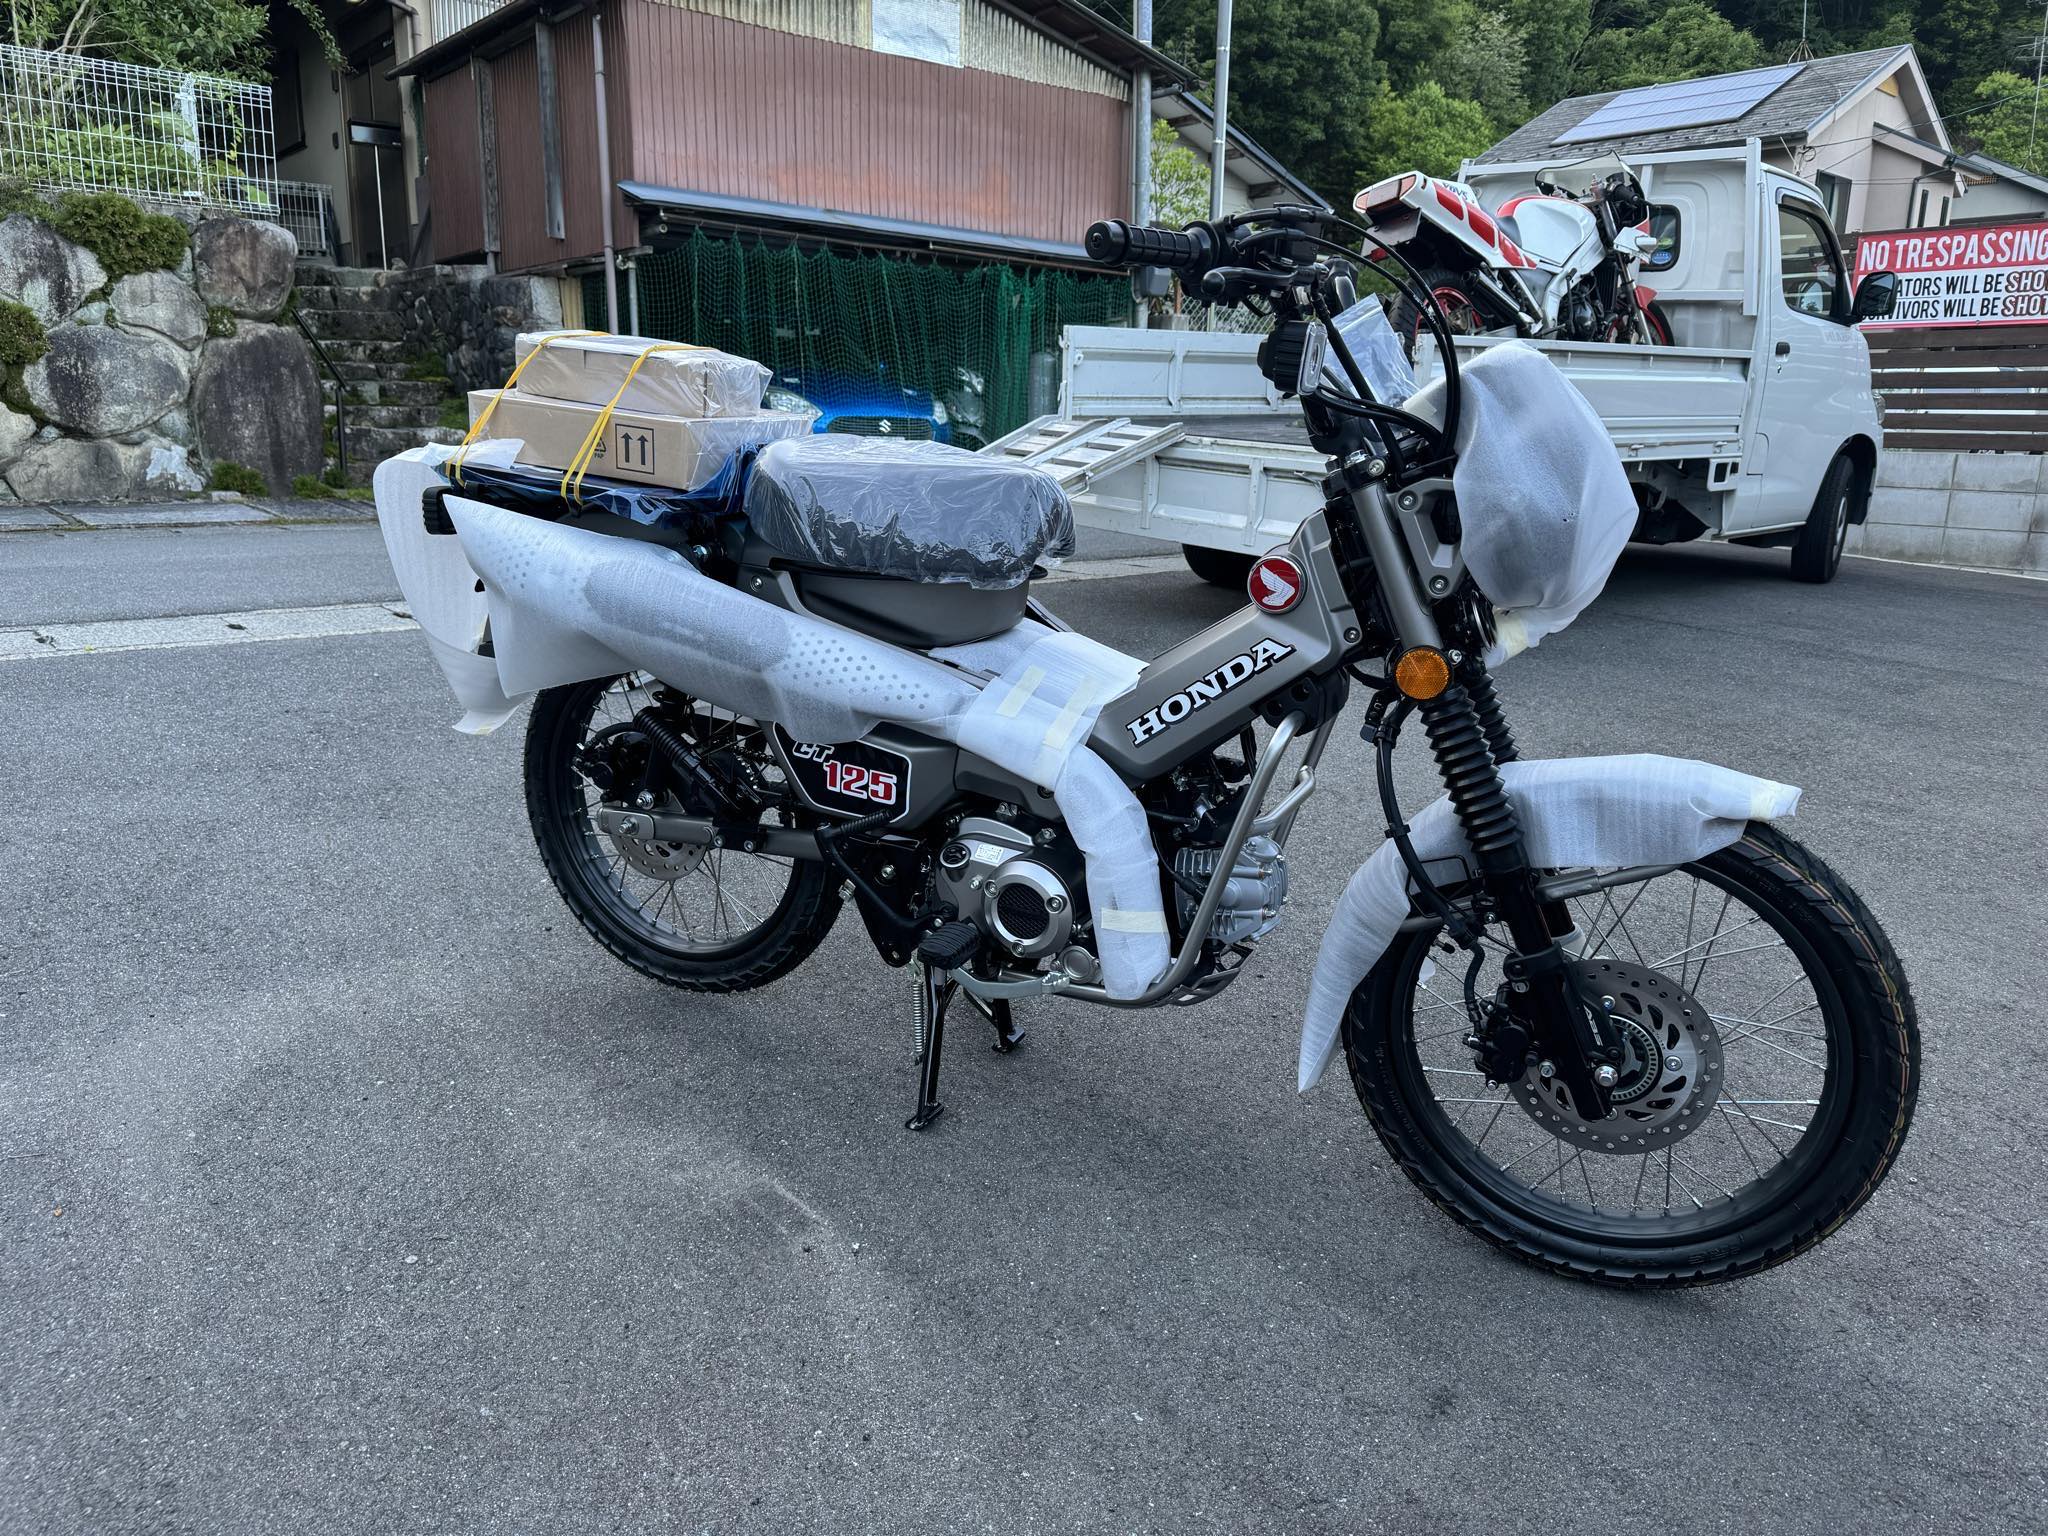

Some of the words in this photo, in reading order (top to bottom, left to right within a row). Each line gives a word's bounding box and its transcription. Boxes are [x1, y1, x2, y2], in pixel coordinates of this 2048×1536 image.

[1859, 240, 1890, 271] NO
[1895, 228, 2048, 269] TRESPASSING
[1946, 274, 1980, 295] WILL
[1983, 273, 2005, 294] BE
[2005, 269, 2048, 293] SHO
[1943, 297, 1977, 318] WILL
[1980, 297, 2001, 317] BE
[1125, 636, 1297, 748] HONDA
[792, 740, 835, 763] CT
[822, 759, 898, 805] 125
[1583, 1003, 1604, 1047] ABS
